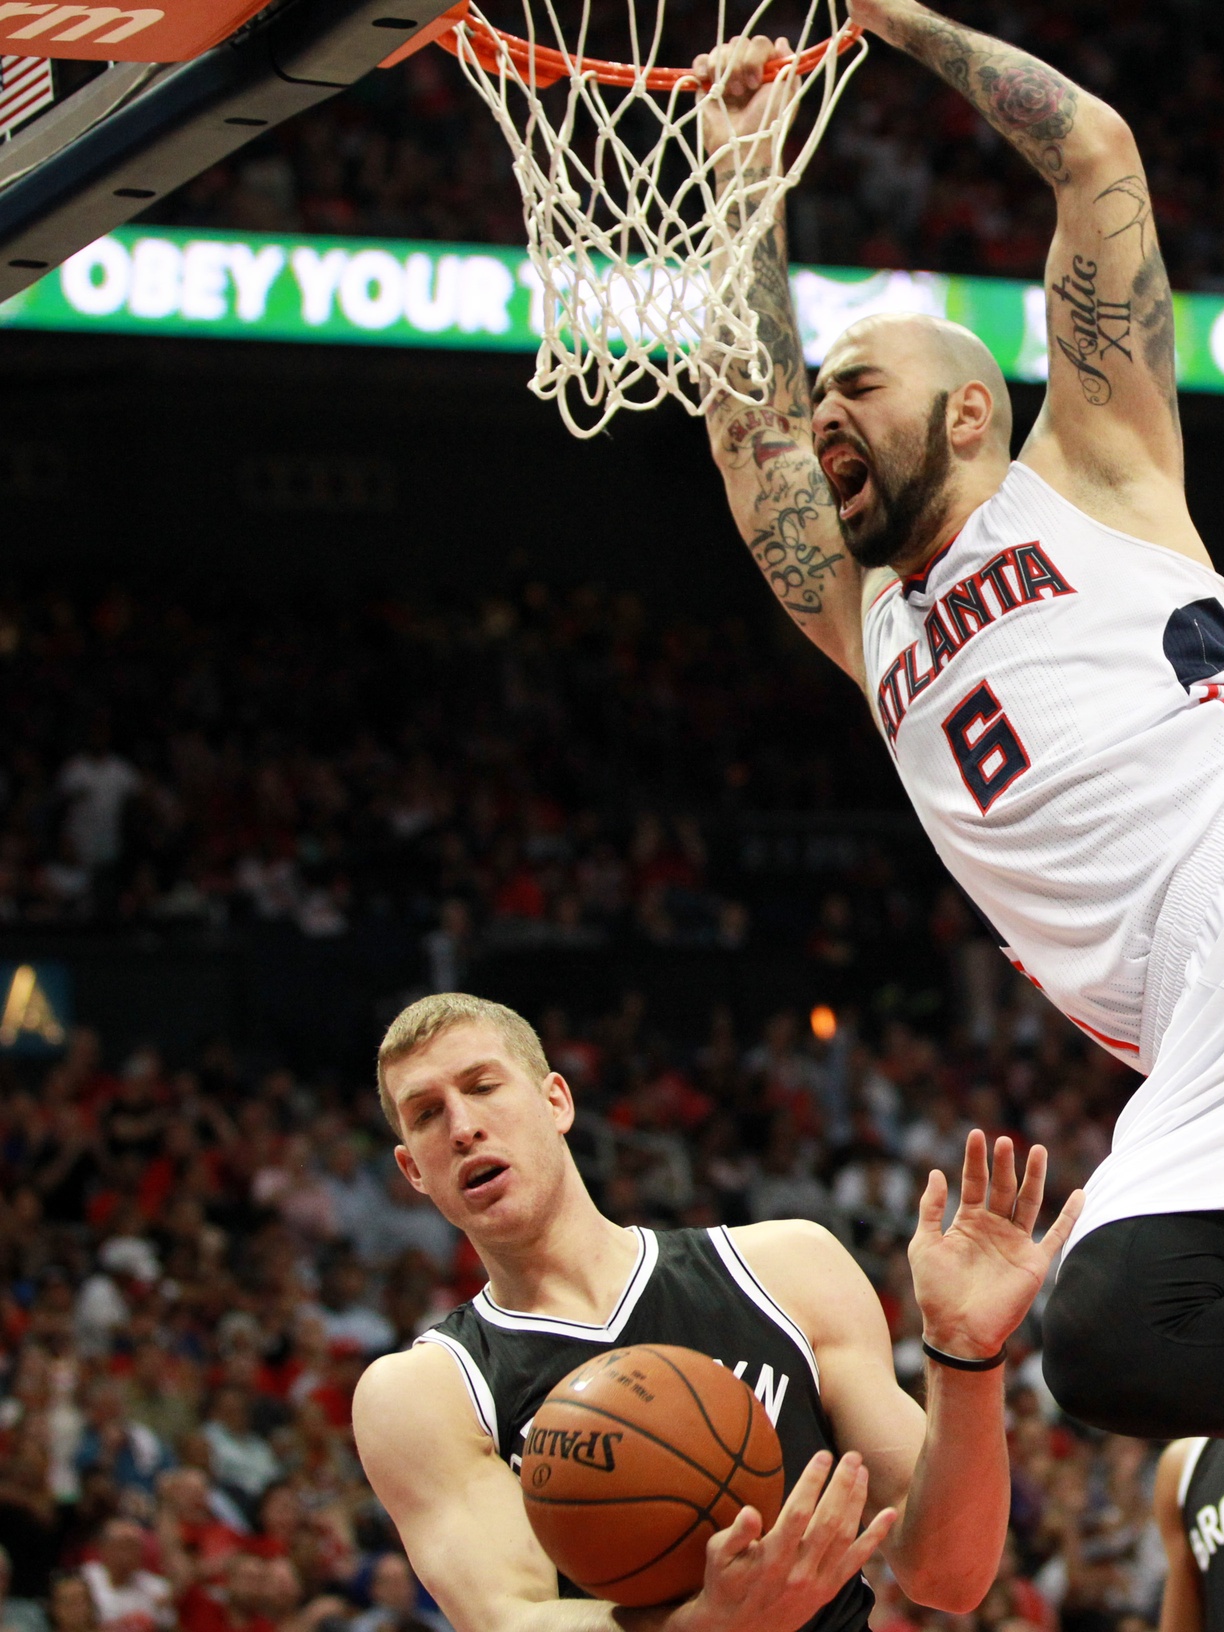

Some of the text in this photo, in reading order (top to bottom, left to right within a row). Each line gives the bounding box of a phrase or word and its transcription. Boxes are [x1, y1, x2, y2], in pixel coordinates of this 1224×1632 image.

[61, 236, 284, 323] OBEY
[291, 246, 515, 335] YOUR
[877, 540, 1078, 761] ATLANTA
[941, 679, 1032, 817] 6
[523, 1426, 624, 1473] SPALDI
